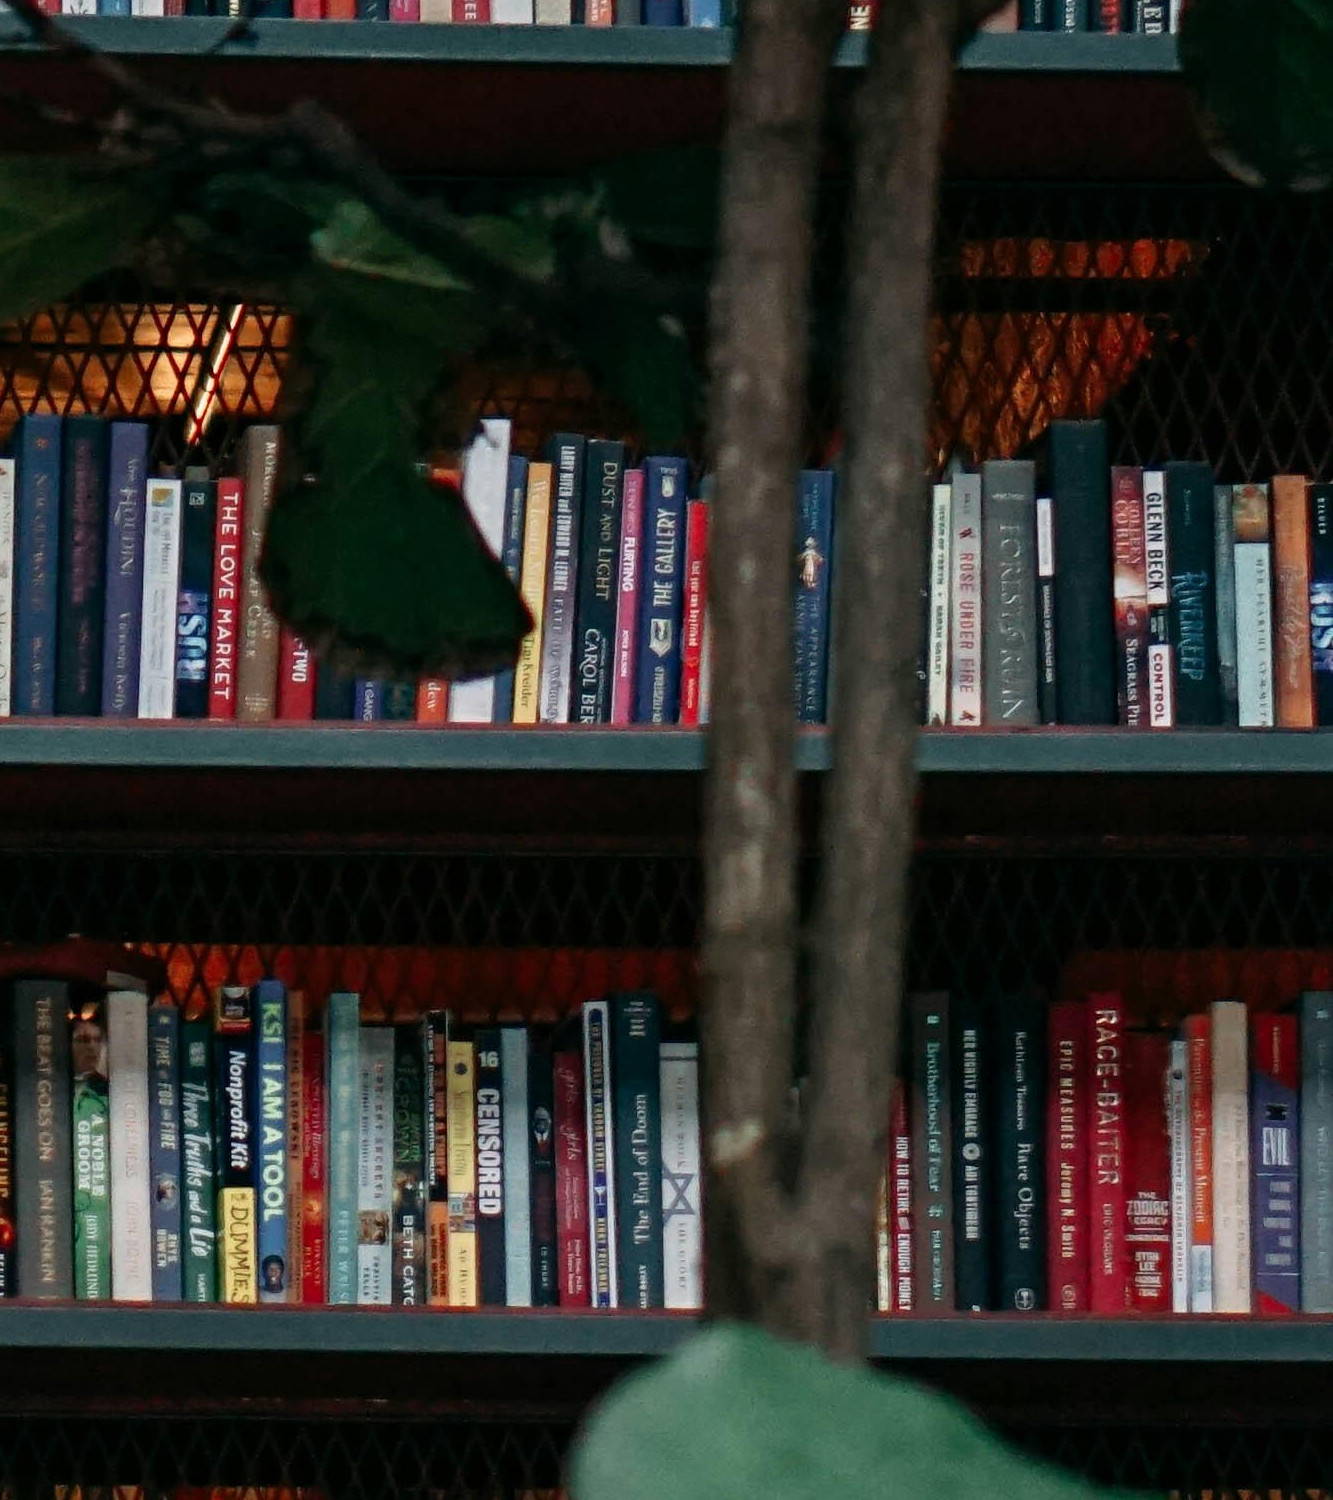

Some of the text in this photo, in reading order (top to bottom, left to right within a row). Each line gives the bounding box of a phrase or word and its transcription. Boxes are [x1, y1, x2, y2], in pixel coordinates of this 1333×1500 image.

[653, 509, 676, 606] THE GALLERY
[1147, 493, 1163, 590] GLENN BECK
[214, 492, 238, 699] THE LOVE MARKET
[1153, 653, 1166, 721] CONTROL
[261, 1002, 283, 1043] KSI
[228, 1051, 246, 1167] Nonprofit Kit
[263, 1075, 283, 1119] AM
[263, 1125, 283, 1145] A
[1095, 1010, 1119, 1185] RACE-BAITER
[263, 1150, 283, 1221] TOOL
[478, 1088, 500, 1214] CENSORED
